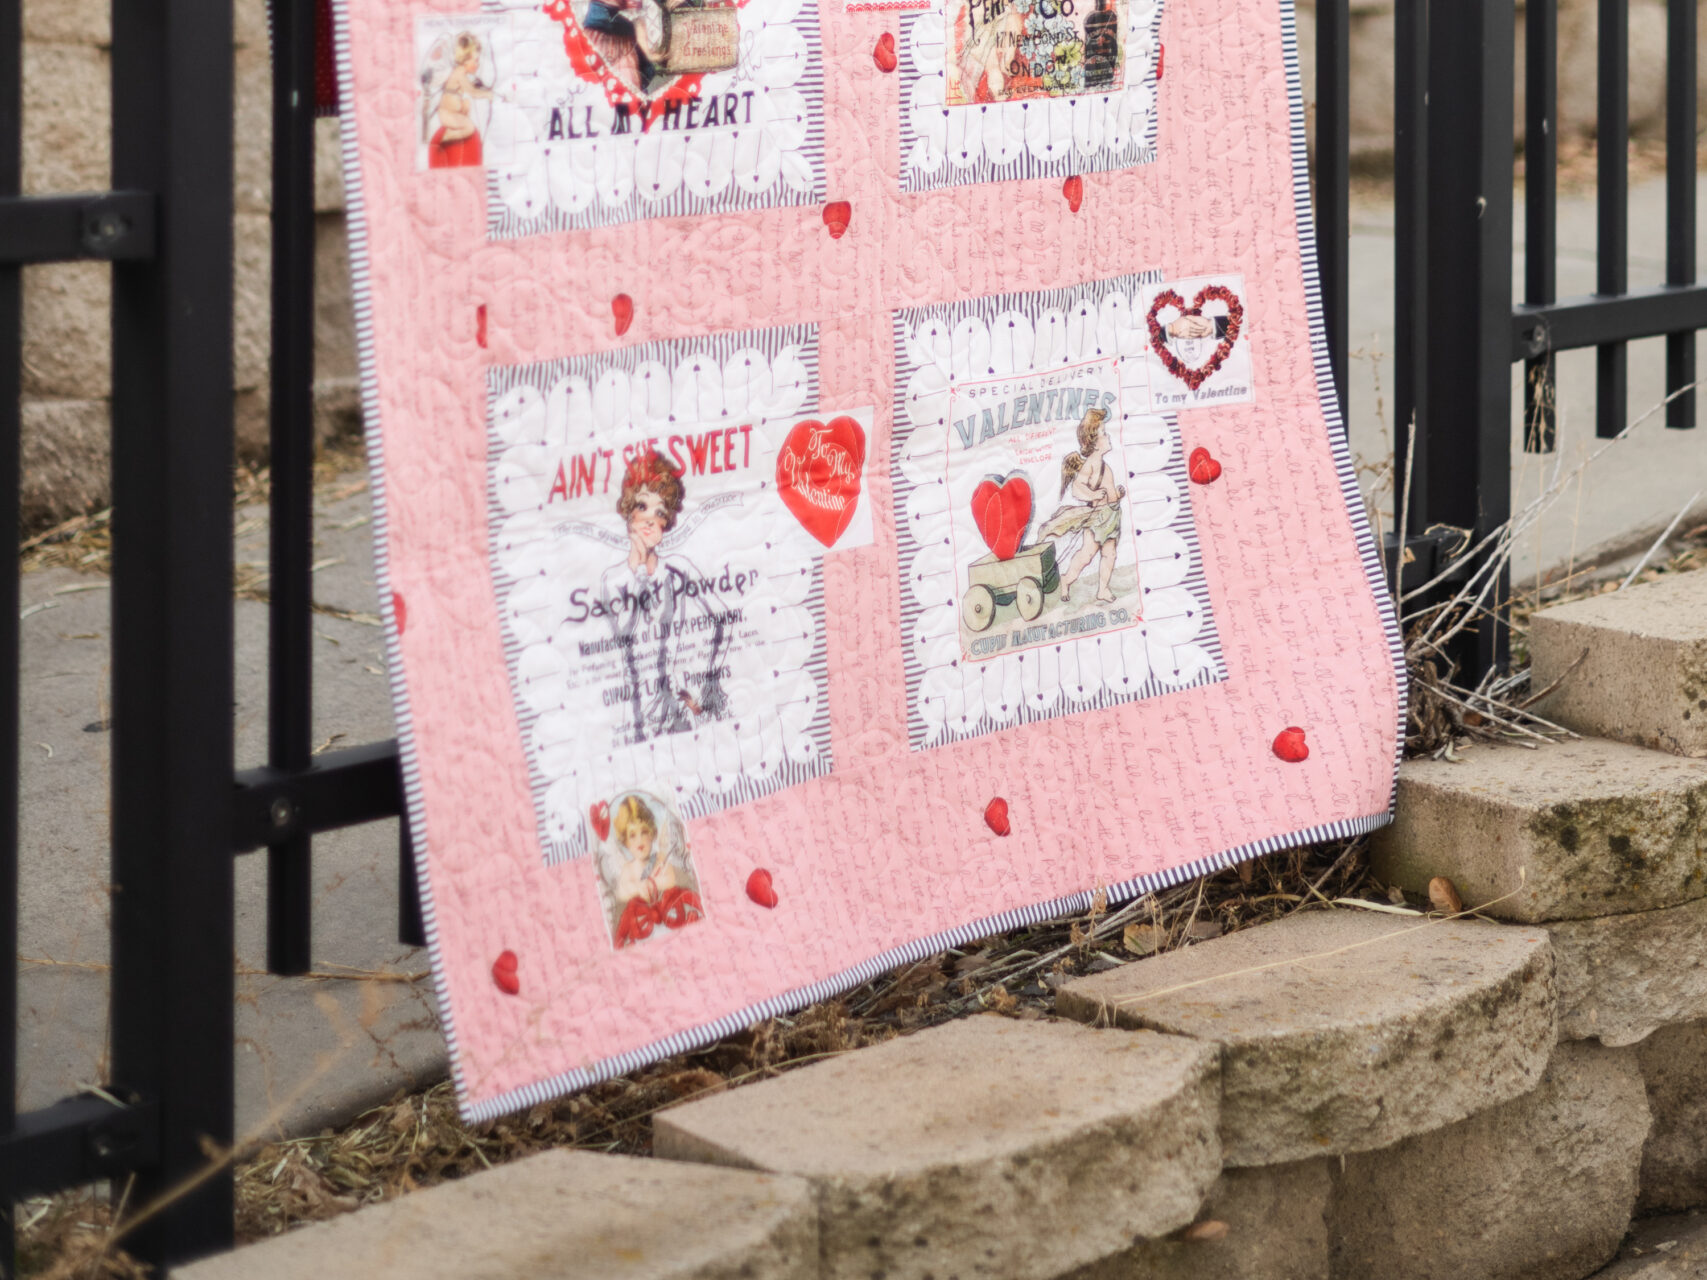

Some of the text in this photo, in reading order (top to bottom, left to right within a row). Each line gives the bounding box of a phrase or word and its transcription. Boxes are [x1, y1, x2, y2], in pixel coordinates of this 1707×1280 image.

[1008, 51, 1067, 78] ONDON
[547, 90, 755, 140] ALL MY HEART
[968, 383, 1034, 398] SPECIAL
[1193, 385, 1248, 400] Valentine
[953, 388, 1117, 450] VALENTINES
[547, 446, 614, 504] AIN'T
[668, 424, 753, 478] SWEET
[808, 427, 833, 460] To
[560, 562, 759, 624] Sachet Powder
